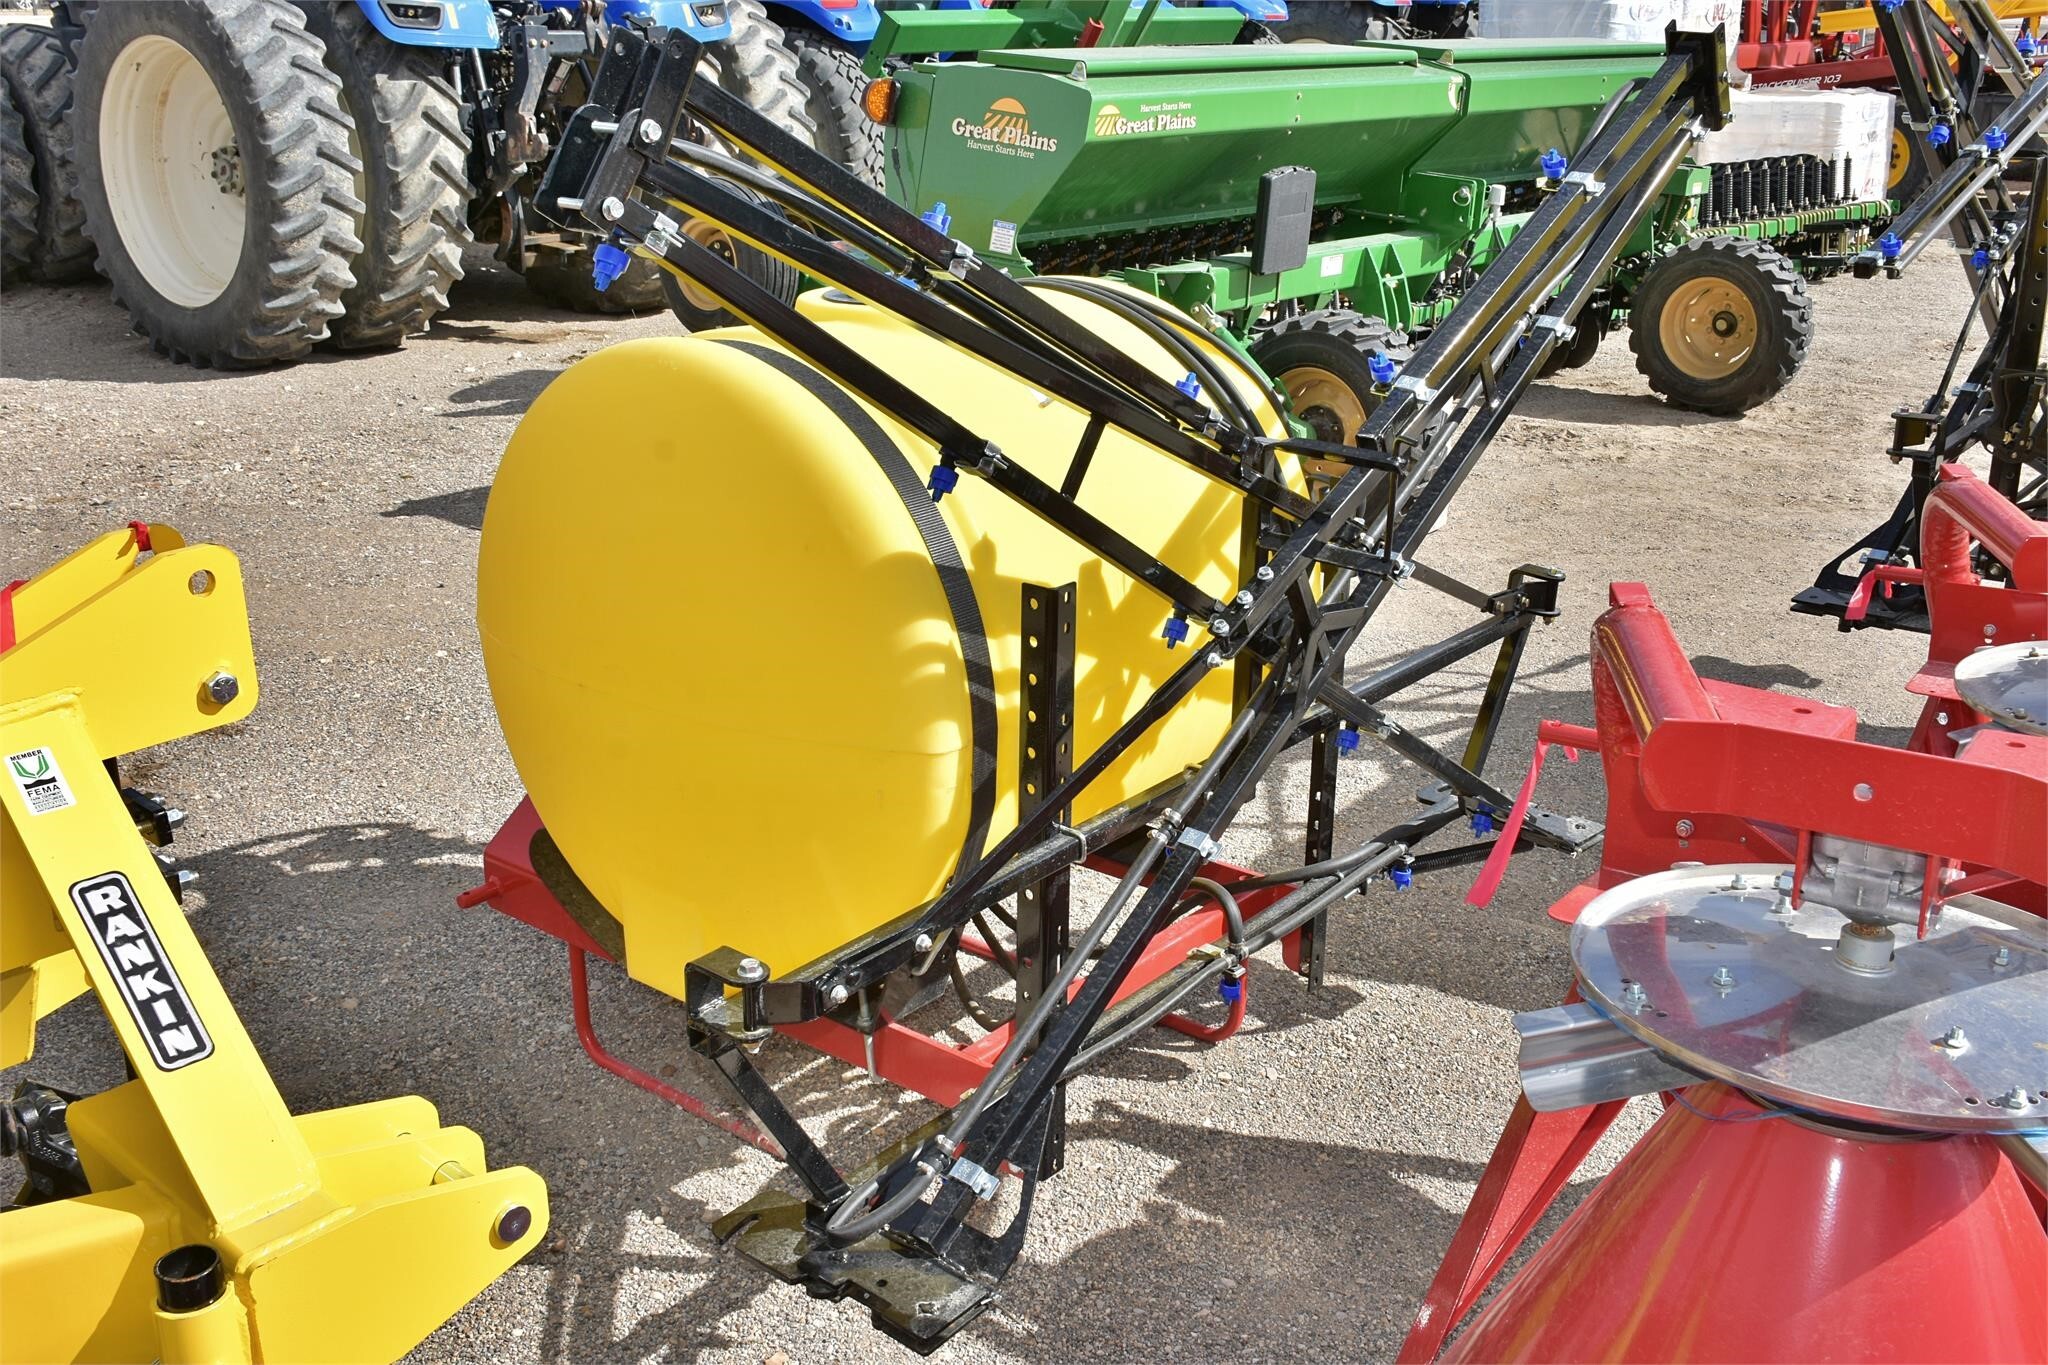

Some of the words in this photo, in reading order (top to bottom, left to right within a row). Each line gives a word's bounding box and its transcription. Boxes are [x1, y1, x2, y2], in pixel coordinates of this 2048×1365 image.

[1824, 74, 1842, 84] 103
[1140, 103, 1162, 113] Harvest
[1162, 102, 1178, 112] Starts
[1178, 101, 1192, 110] Here
[1115, 116, 1156, 135] Great
[1156, 113, 1197, 132] Plains
[951, 117, 1001, 142] Great
[1002, 125, 1058, 152] Plains
[966, 139, 994, 152] Harvest
[994, 143, 1016, 156] Starts
[1016, 148, 1035, 159] Here
[10, 749, 43, 762] MEMBER
[26, 783, 61, 798] FEMA
[84, 884, 199, 1058] RANKIN
